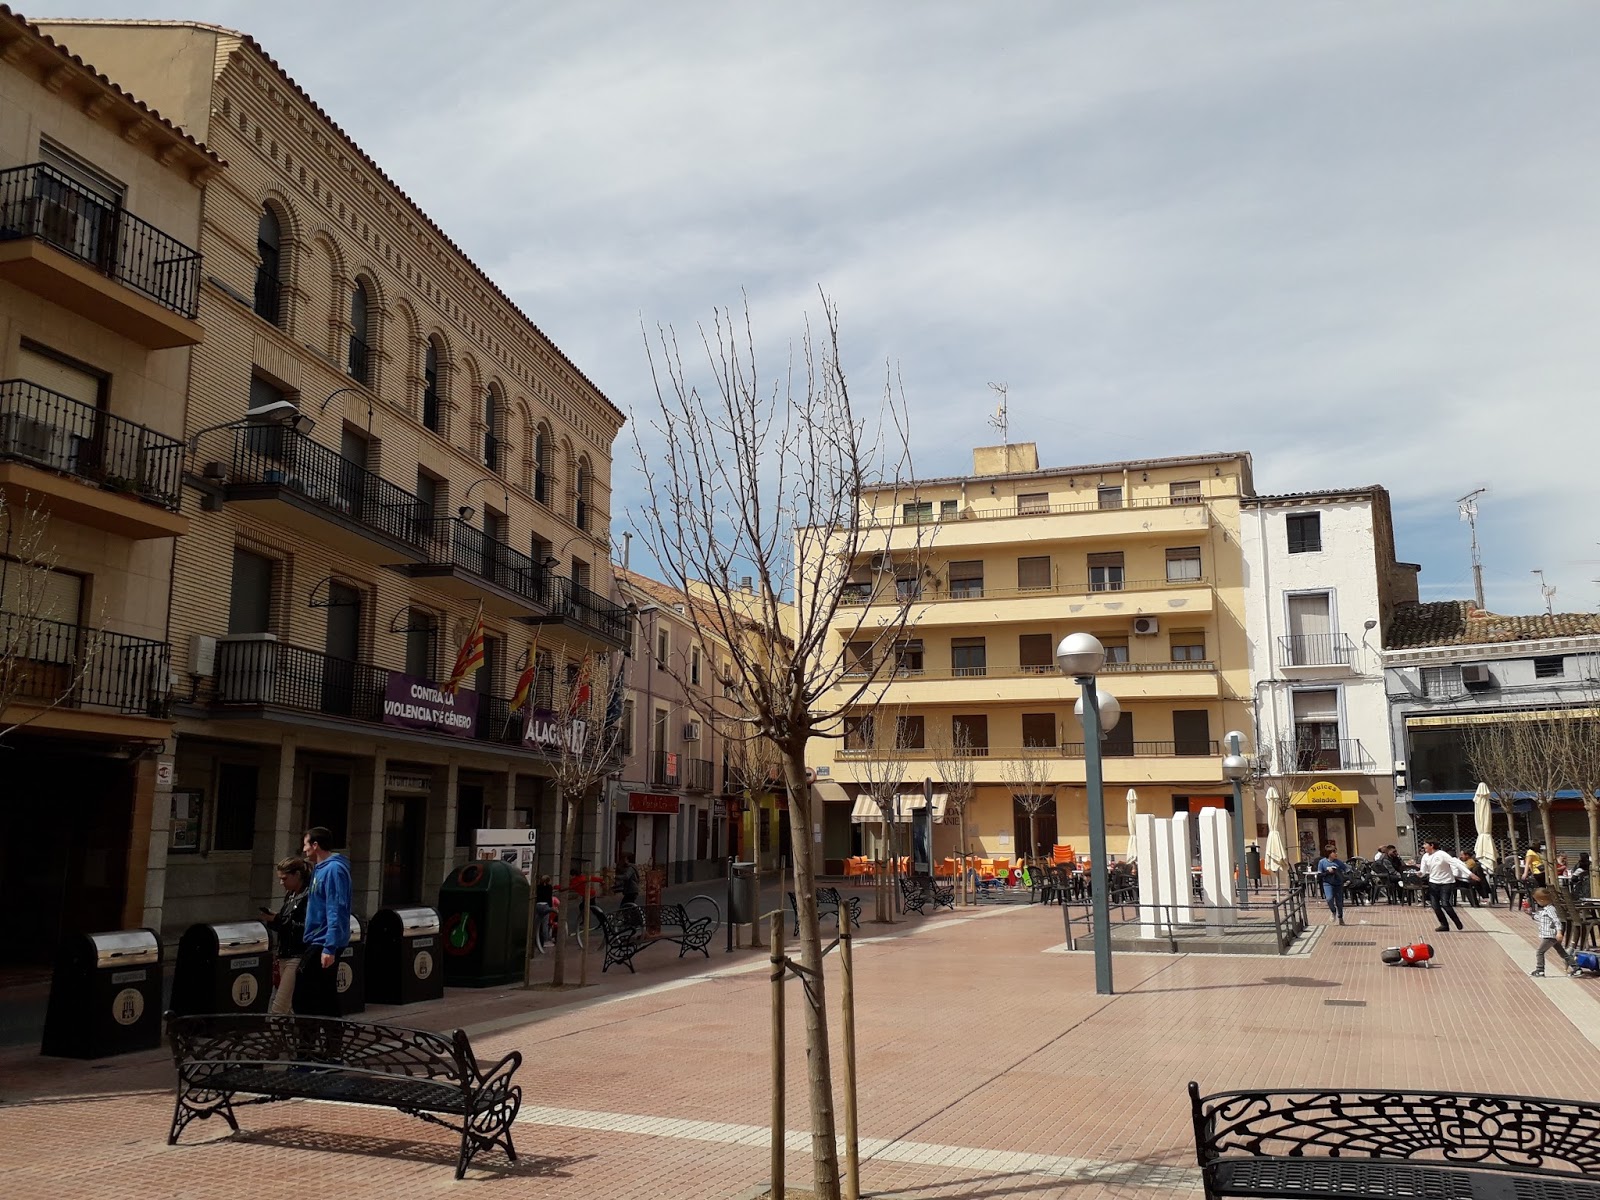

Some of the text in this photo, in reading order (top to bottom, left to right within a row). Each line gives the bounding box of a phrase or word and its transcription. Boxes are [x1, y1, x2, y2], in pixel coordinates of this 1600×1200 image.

[410, 684, 455, 706] CONTRA LA
[384, 700, 472, 729] VIOLENCIA DE GÉNERO
[1311, 784, 1337, 793] Dulces
